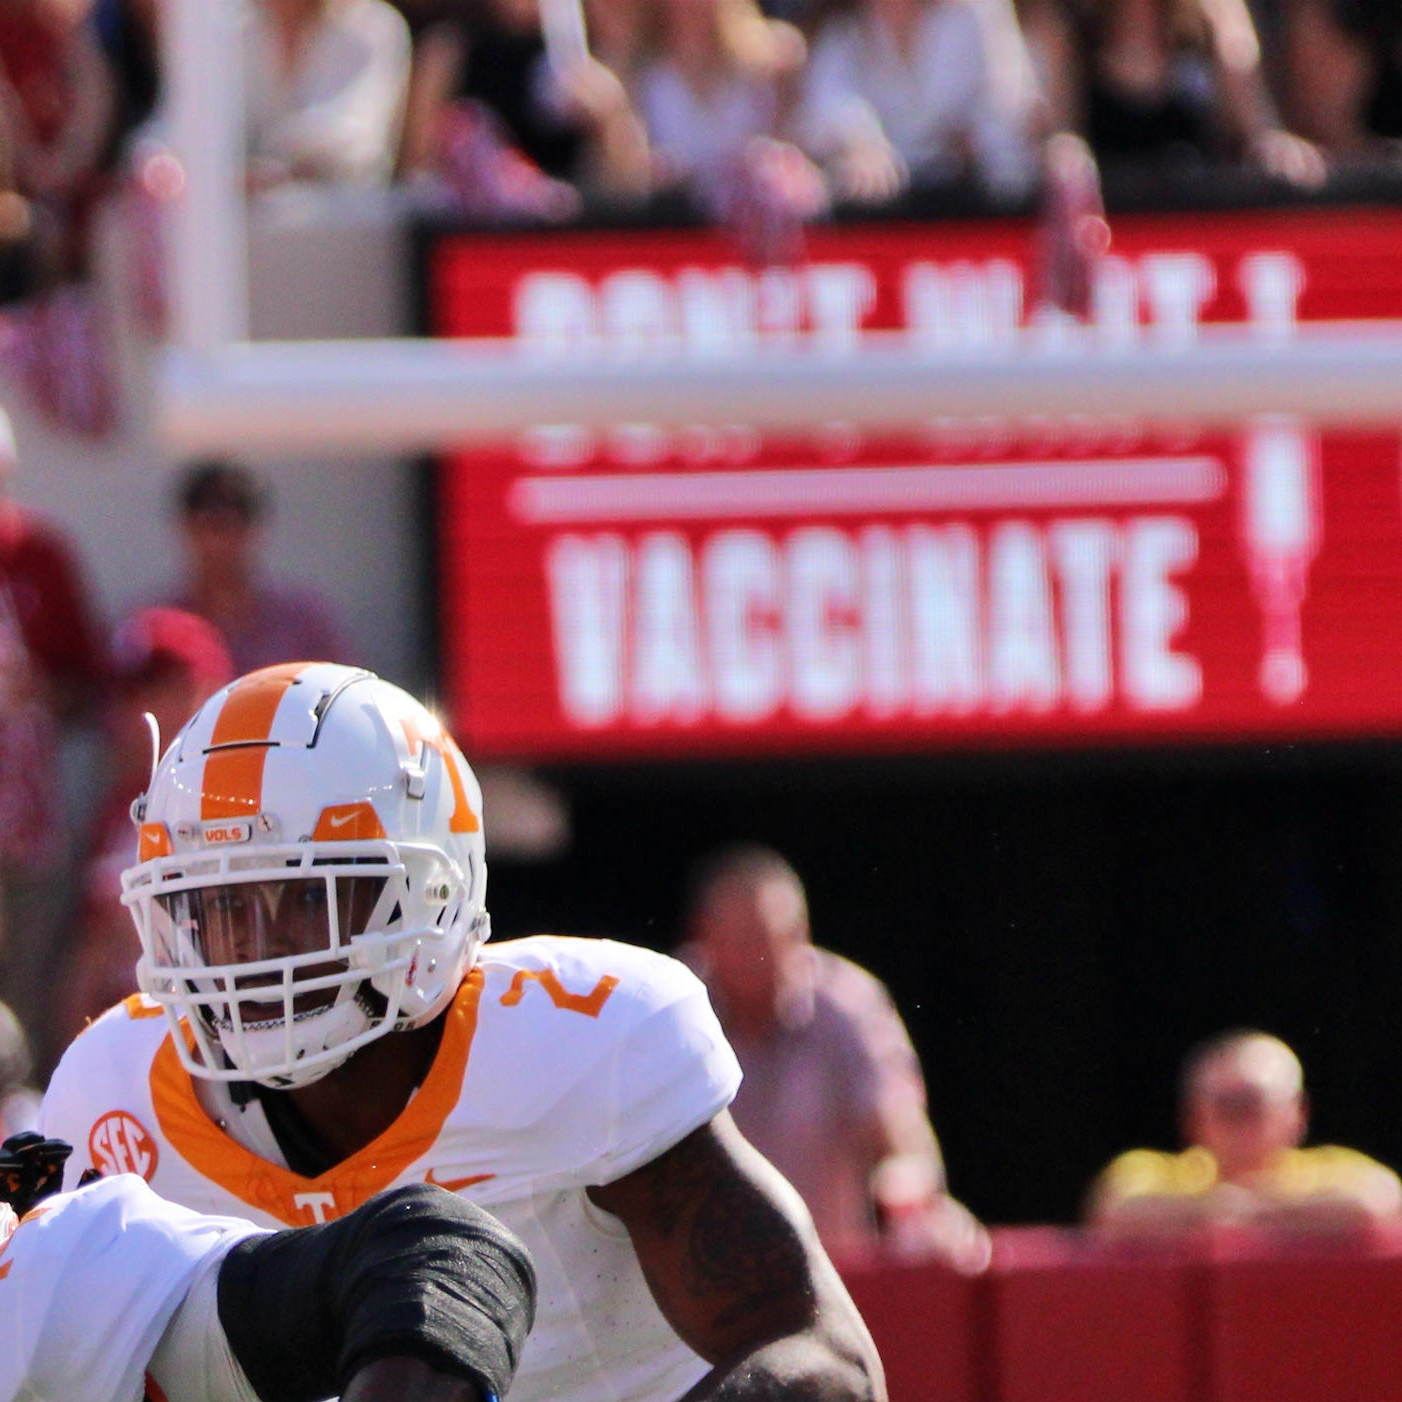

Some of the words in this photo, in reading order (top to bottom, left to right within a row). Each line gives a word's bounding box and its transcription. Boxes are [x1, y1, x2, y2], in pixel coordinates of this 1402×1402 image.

[546, 515, 1202, 726] VACCINATE
[205, 826, 242, 842] VOLS
[92, 1114, 151, 1177] SEC
[293, 1191, 335, 1225] T
